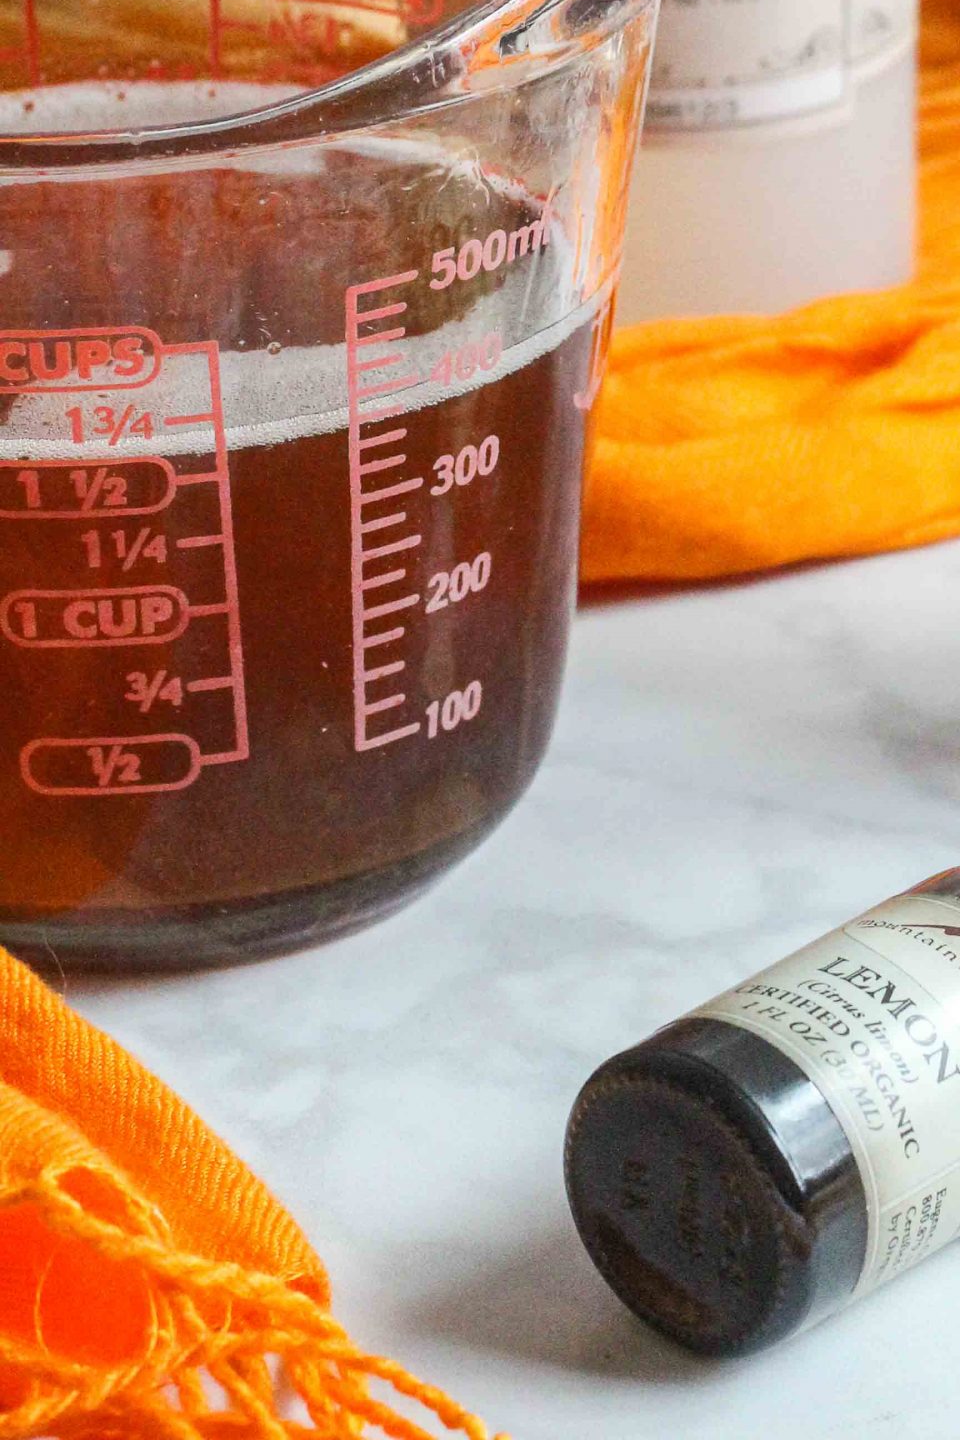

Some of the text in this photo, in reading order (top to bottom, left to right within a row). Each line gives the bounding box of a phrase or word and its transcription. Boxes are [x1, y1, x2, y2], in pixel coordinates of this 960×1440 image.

[429, 203, 551, 290] 500ml
[0, 337, 145, 381] CUPS
[429, 332, 503, 386] 400
[431, 435, 500, 496] 300
[426, 552, 492, 614] 200
[15, 597, 174, 639] 1 CUP
[425, 681, 483, 739] 100
[858, 919, 957, 962] mountain
[798, 978, 865, 1019] (Citrus
[818, 956, 960, 1084] LEMON
[735, 983, 920, 1159] CERTIFIED ORGANIC
[758, 1006, 786, 1022] FL
[789, 1020, 828, 1046] OZ
[850, 1086, 884, 1132] ML)
